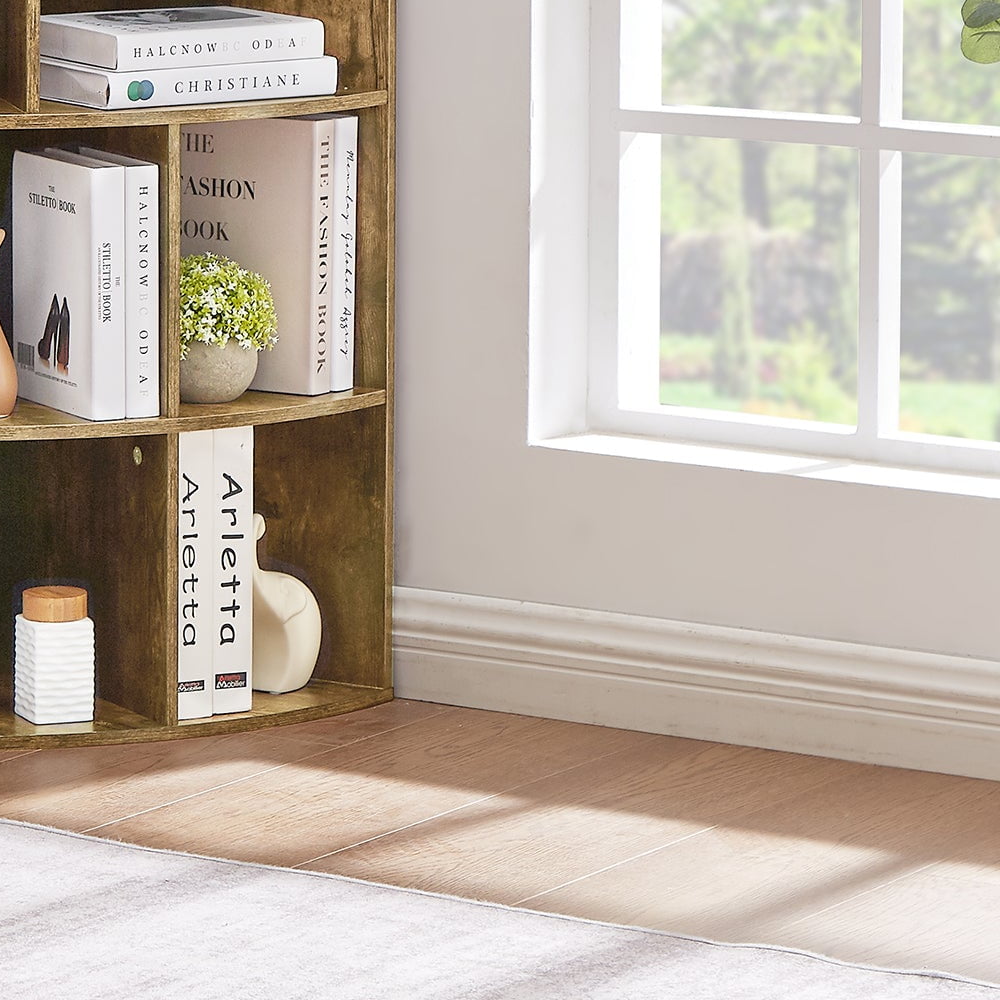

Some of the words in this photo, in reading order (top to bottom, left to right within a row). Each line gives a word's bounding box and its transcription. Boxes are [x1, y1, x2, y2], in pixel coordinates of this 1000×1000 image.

[175, 73, 301, 94] CHRISTIANE
[181, 132, 214, 154] HE
[319, 135, 330, 188] THE
[180, 175, 256, 200] ASHON
[28, 192, 57, 209] STILETTO
[59, 199, 76, 215] BOOK
[180, 218, 230, 241] OOK
[102, 242, 112, 290] STILETTO
[102, 294, 112, 323] BOOK
[317, 305, 327, 374] BOOK
[182, 472, 199, 647] Arletta
[219, 472, 244, 646] Arletta
